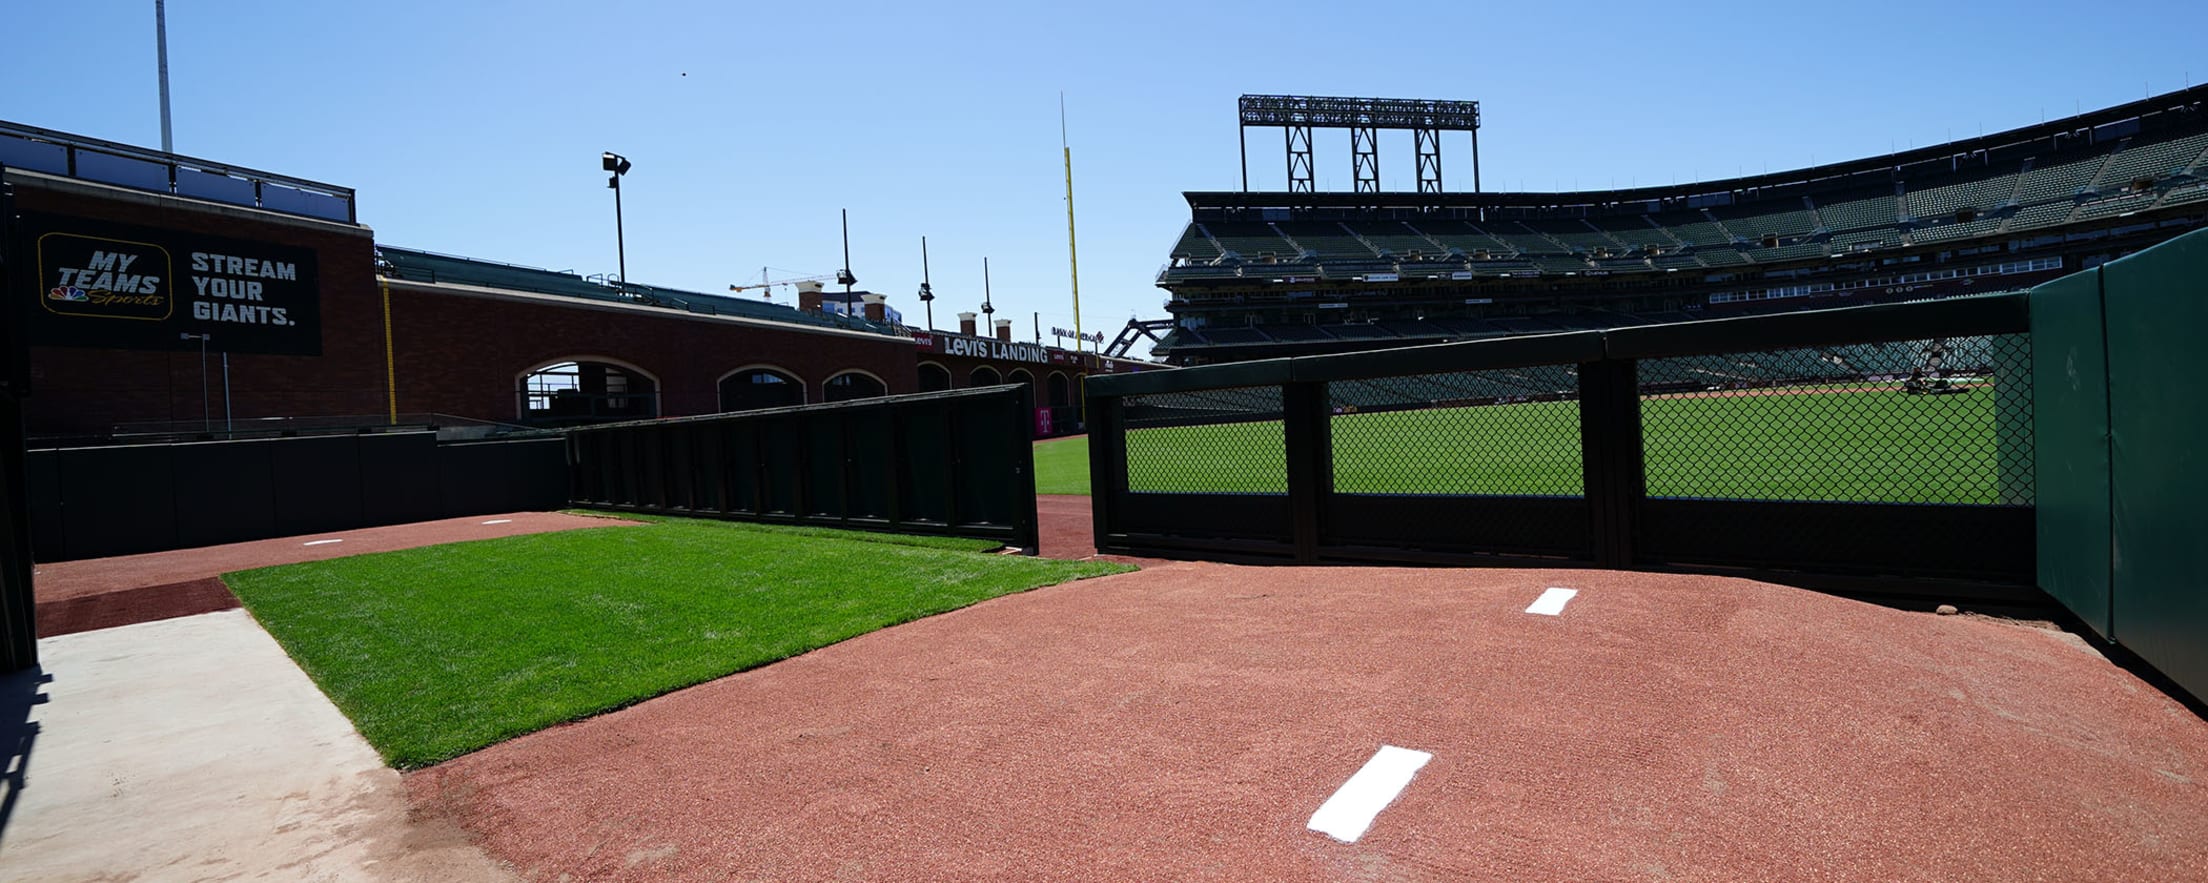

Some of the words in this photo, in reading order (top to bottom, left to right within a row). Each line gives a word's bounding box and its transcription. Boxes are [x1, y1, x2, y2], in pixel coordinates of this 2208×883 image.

[88, 250, 138, 273] MY
[191, 251, 297, 281] STREAM
[57, 267, 160, 295] TEAMS
[191, 275, 264, 301] YOUR
[87, 290, 165, 306] Sports
[193, 301, 296, 326] GIANTS.
[991, 342, 1049, 364] LANDING
[1040, 409, 1050, 433] T
